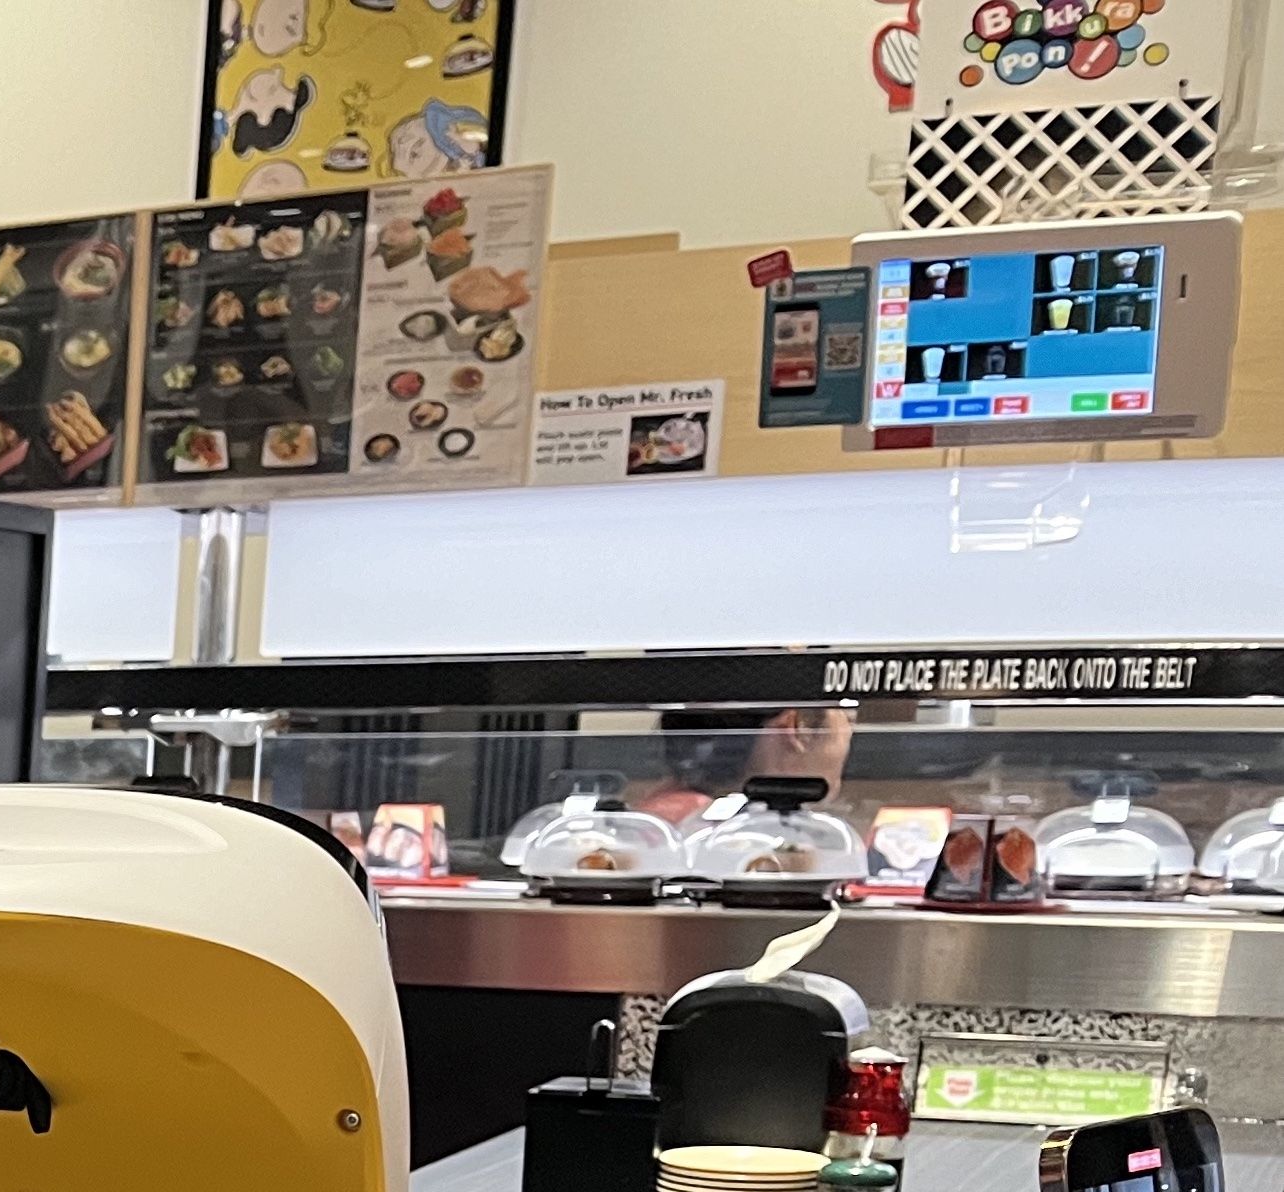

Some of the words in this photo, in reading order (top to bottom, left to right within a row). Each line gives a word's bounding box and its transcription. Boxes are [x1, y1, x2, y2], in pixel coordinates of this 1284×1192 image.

[982, 1, 1135, 37] Bikkura
[597, 393, 635, 410] Open
[822, 660, 848, 693] DO
[849, 660, 884, 692] NOT
[885, 659, 936, 692] PLACE
[939, 659, 970, 691] THE
[971, 658, 1022, 690] PLATE
[1023, 657, 1071, 690] BACK
[1071, 657, 1118, 689] ONTO
[1119, 656, 1152, 689] THE
[1154, 656, 1197, 689] BELT
